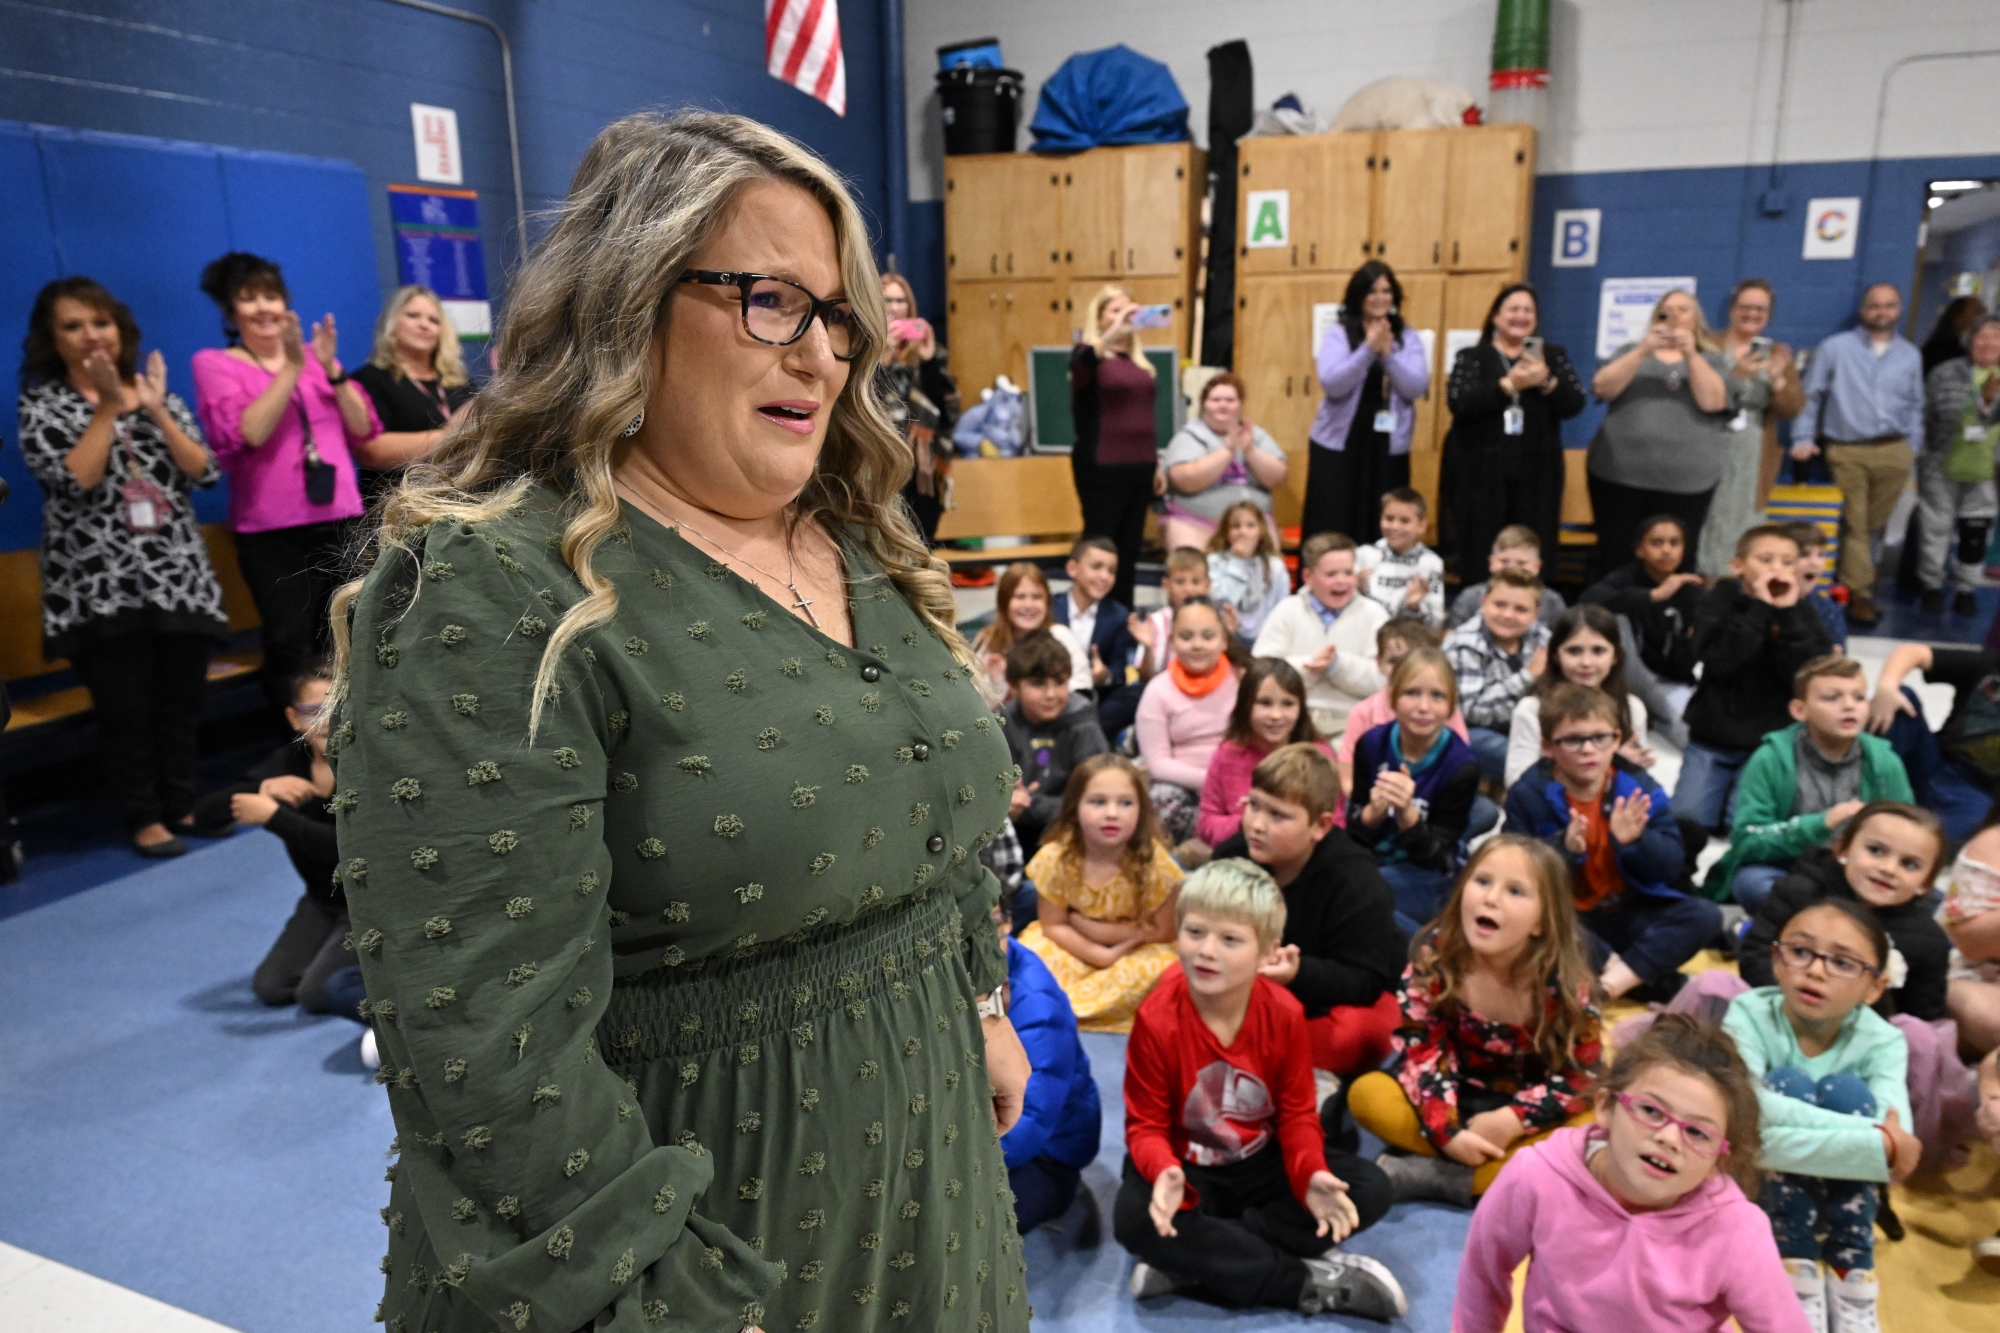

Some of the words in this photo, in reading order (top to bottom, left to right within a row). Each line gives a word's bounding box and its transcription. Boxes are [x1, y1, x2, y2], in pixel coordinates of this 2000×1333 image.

[1252, 200, 1283, 241] A
[1562, 219, 1589, 258] B
[1815, 209, 1847, 242] C
